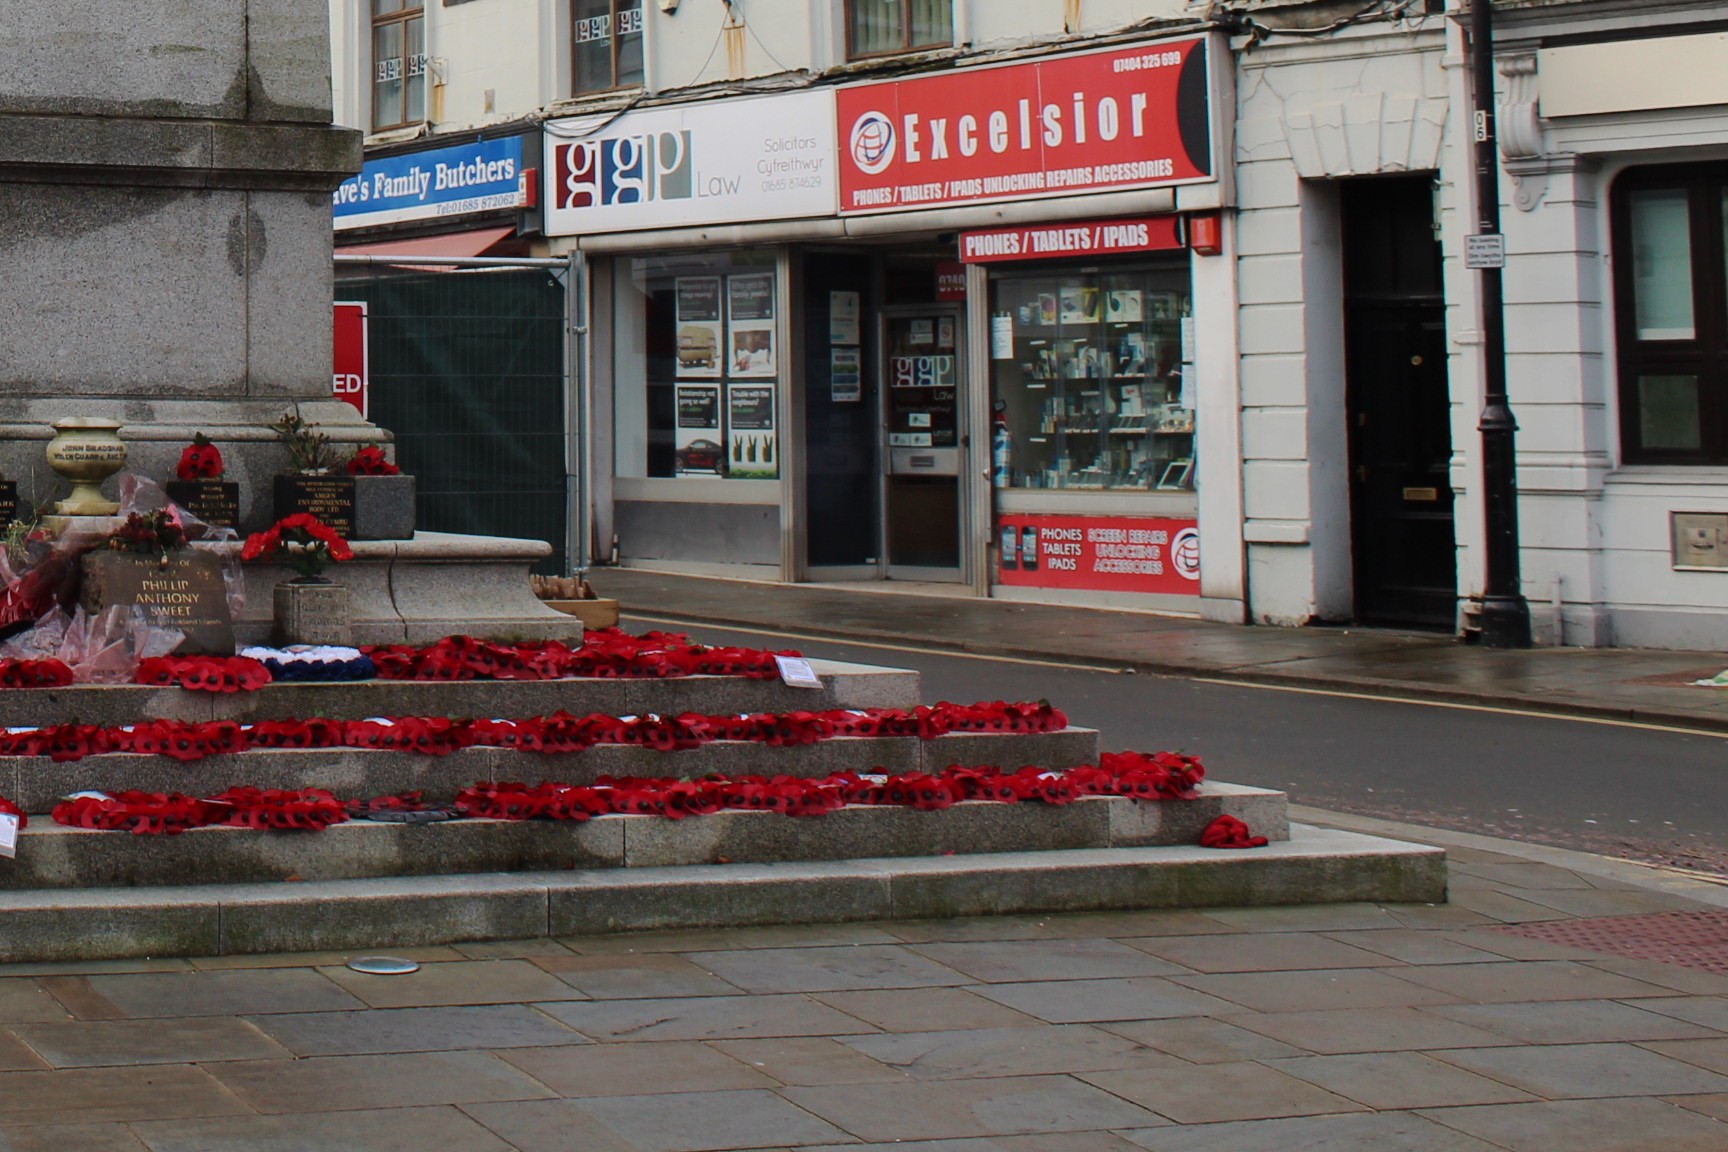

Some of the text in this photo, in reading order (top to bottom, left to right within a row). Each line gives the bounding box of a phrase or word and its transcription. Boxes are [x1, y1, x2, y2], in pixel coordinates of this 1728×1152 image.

[576, 15, 611, 43] ggp
[618, 8, 642, 35] gg
[408, 54, 425, 76] gg
[1114, 51, 1181, 73] 07404 325 699
[904, 92, 1147, 163] Excelsior
[764, 135, 816, 153] Solicitors
[560, 130, 692, 209] ggp
[757, 155, 824, 177] Cyfreithwyr
[333, 176, 369, 205] ave's
[373, 166, 431, 200] Family
[435, 155, 515, 190] Butchers
[698, 171, 741, 198] Law
[762, 177, 786, 192] 01685
[853, 187, 892, 207] PHONES
[900, 183, 942, 202] TABLETS
[950, 179, 983, 198] IPADS
[984, 172, 1045, 194] UNLOCKING
[1046, 167, 1093, 189] REPAIRS
[1094, 159, 1173, 184] ACCESSORIES
[436, 194, 515, 215] Tel:01685 872062
[966, 232, 1020, 257] PHONES
[1031, 227, 1091, 252] TABLETS
[1103, 224, 1148, 247] IPADS
[939, 273, 966, 292] 0740
[891, 355, 955, 387] ggp
[333, 373, 362, 393] ED
[933, 388, 955, 401] Law
[1041, 528, 1082, 541] PHONES
[1087, 528, 1168, 544] SCREEN REPAIRS
[1042, 543, 1082, 556] TABLETS
[1095, 544, 1160, 559] UNLOCKING
[1048, 558, 1076, 570] IPADS
[1093, 560, 1163, 575] ACCESSORIES
[136, 593, 200, 603] ANTHONY
[150, 606, 192, 617] SWEET
